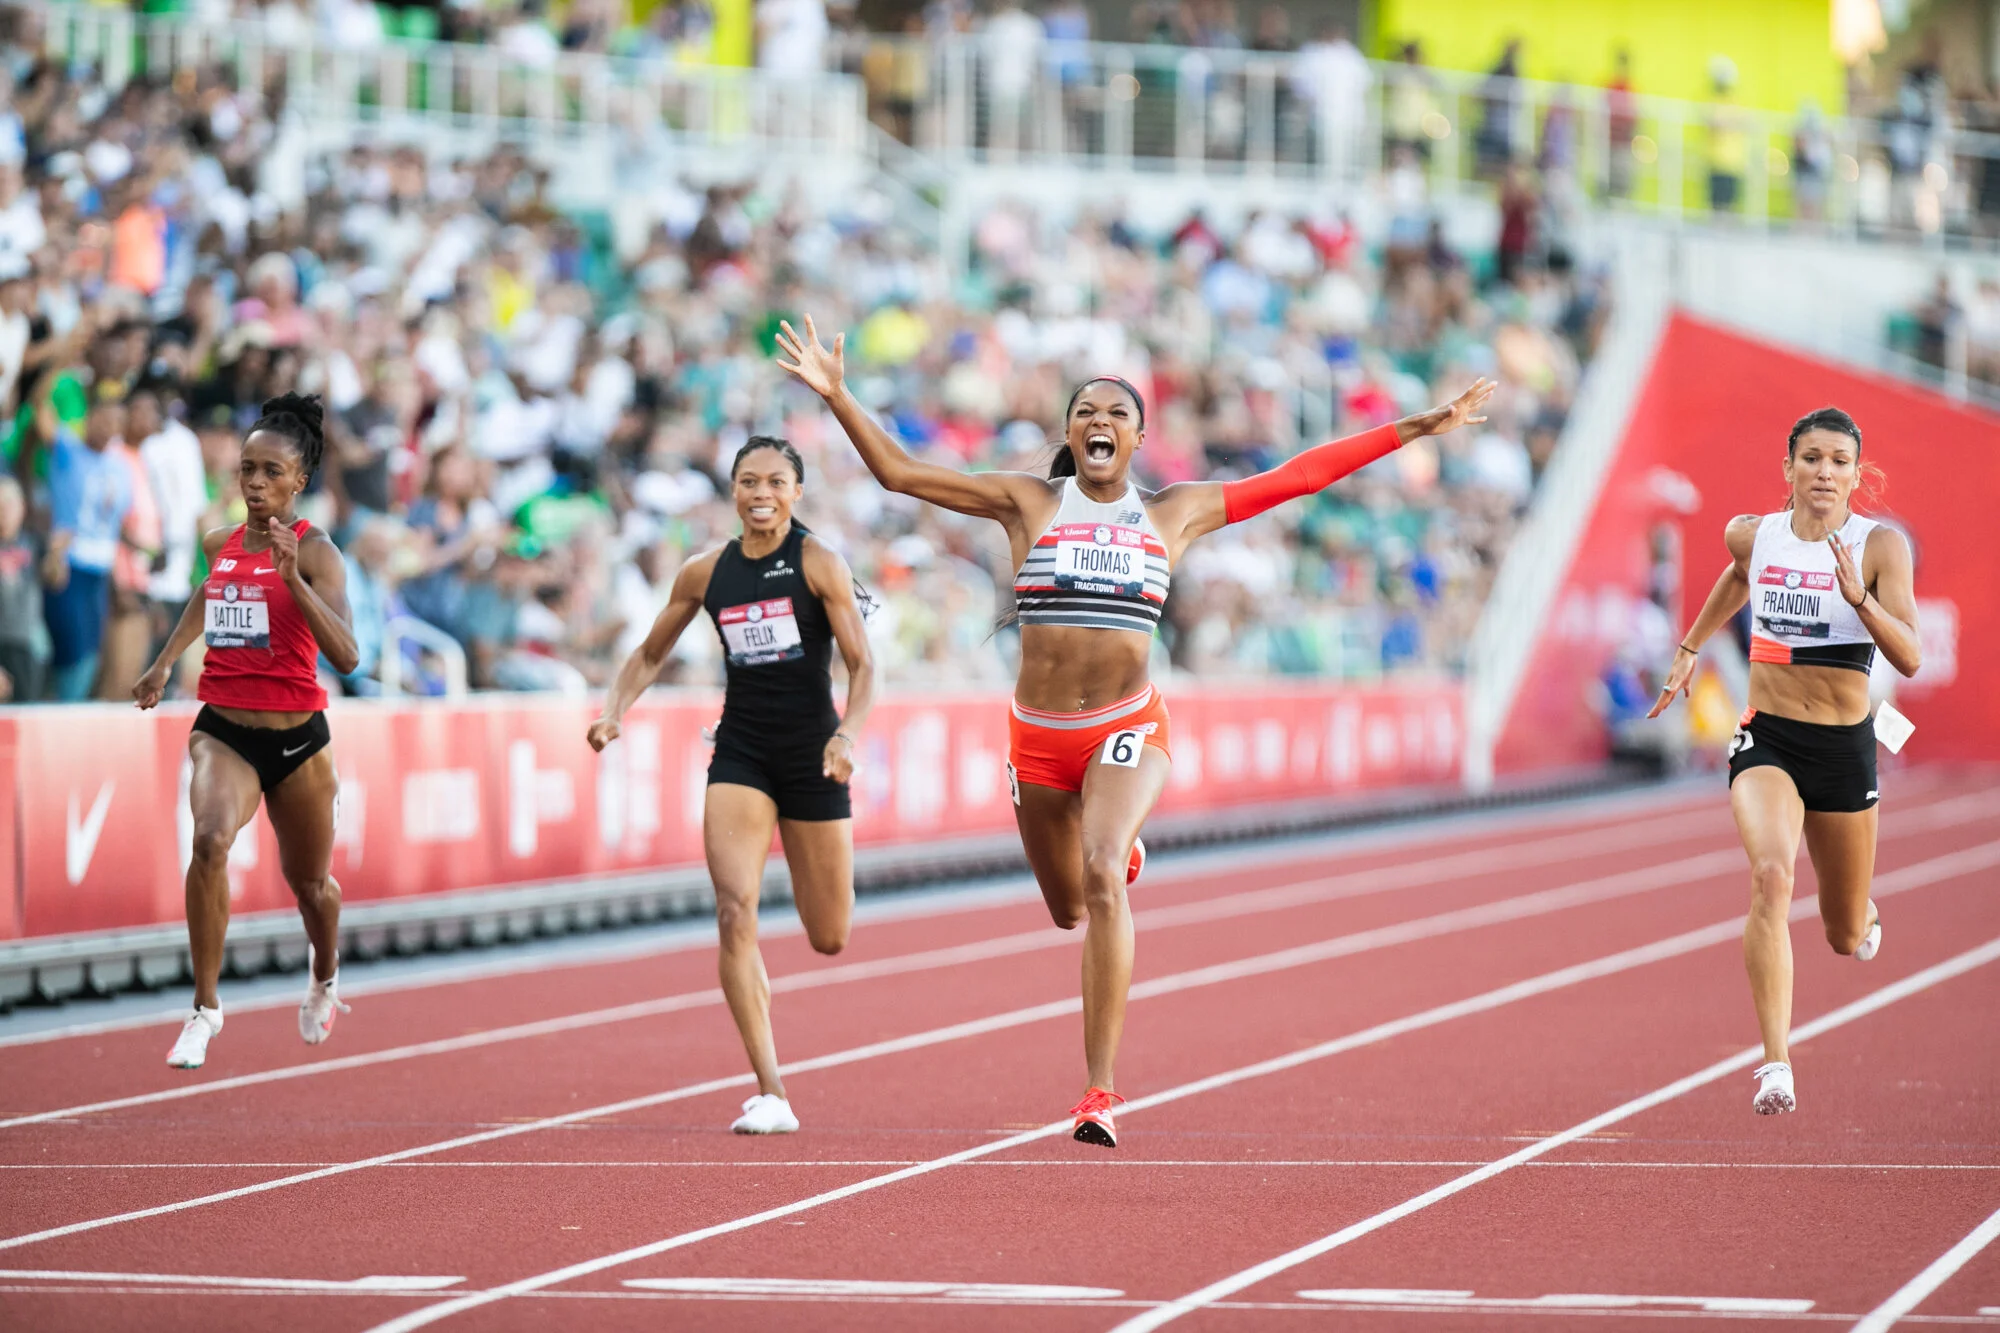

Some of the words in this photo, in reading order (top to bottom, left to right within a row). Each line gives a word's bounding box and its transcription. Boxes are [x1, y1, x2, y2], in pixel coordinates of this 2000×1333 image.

[1072, 547, 1131, 575] THOMAS
[1762, 590, 1821, 618] PRANDINI
[743, 623, 777, 648] FELIX
[1111, 731, 1136, 763] 6
